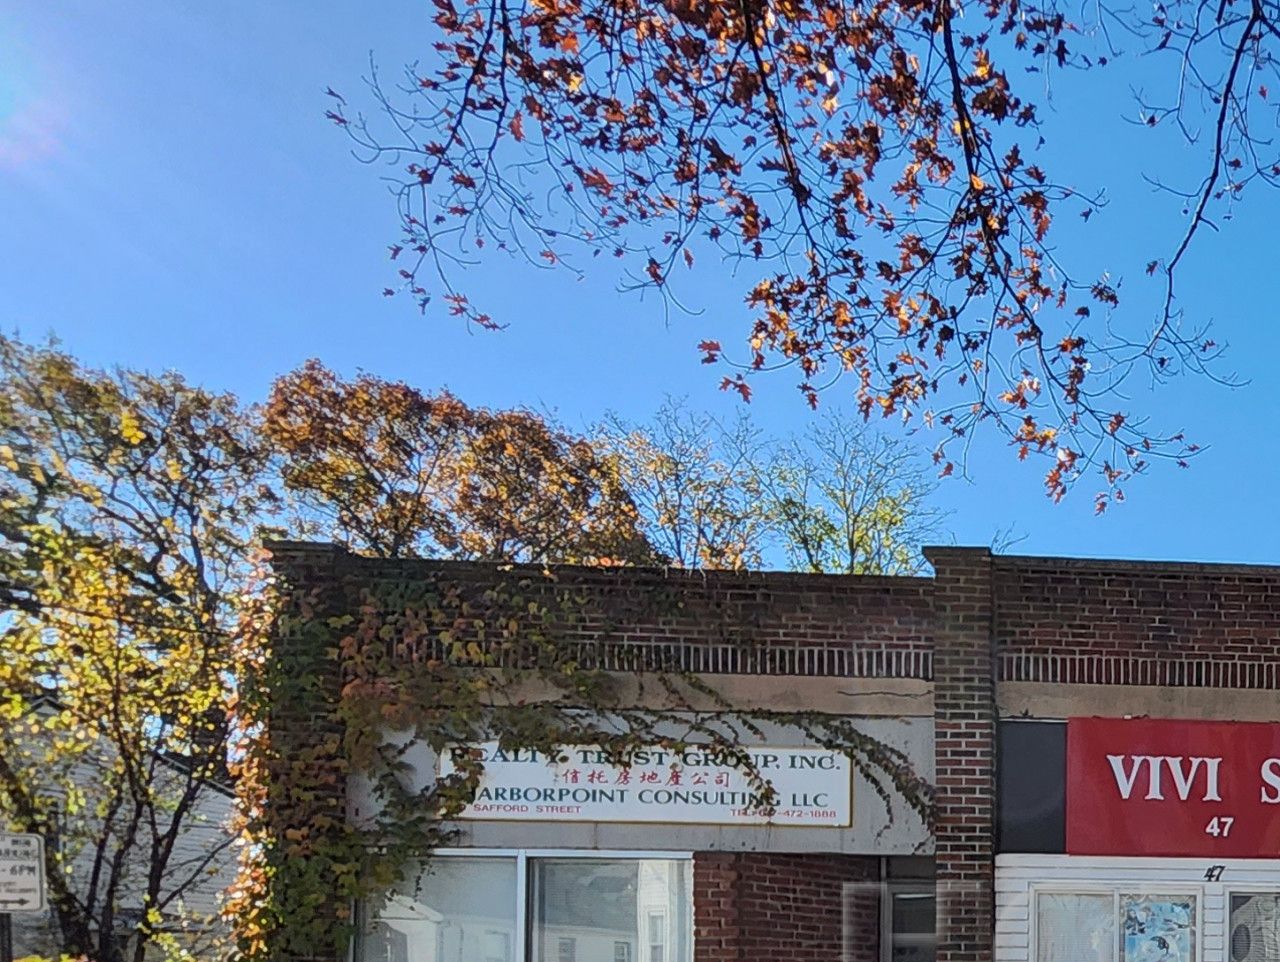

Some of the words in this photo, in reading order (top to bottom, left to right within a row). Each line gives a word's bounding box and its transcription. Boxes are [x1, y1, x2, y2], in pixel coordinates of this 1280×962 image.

[576, 748, 669, 766] TRUST
[789, 754, 841, 770] INC.
[1106, 754, 1223, 802] VIVI
[473, 803, 529, 813] SAFFORD
[535, 804, 582, 814] STREET
[791, 792, 829, 807] LLC
[1205, 815, 1235, 837] 47
[1204, 865, 1226, 882] 47
